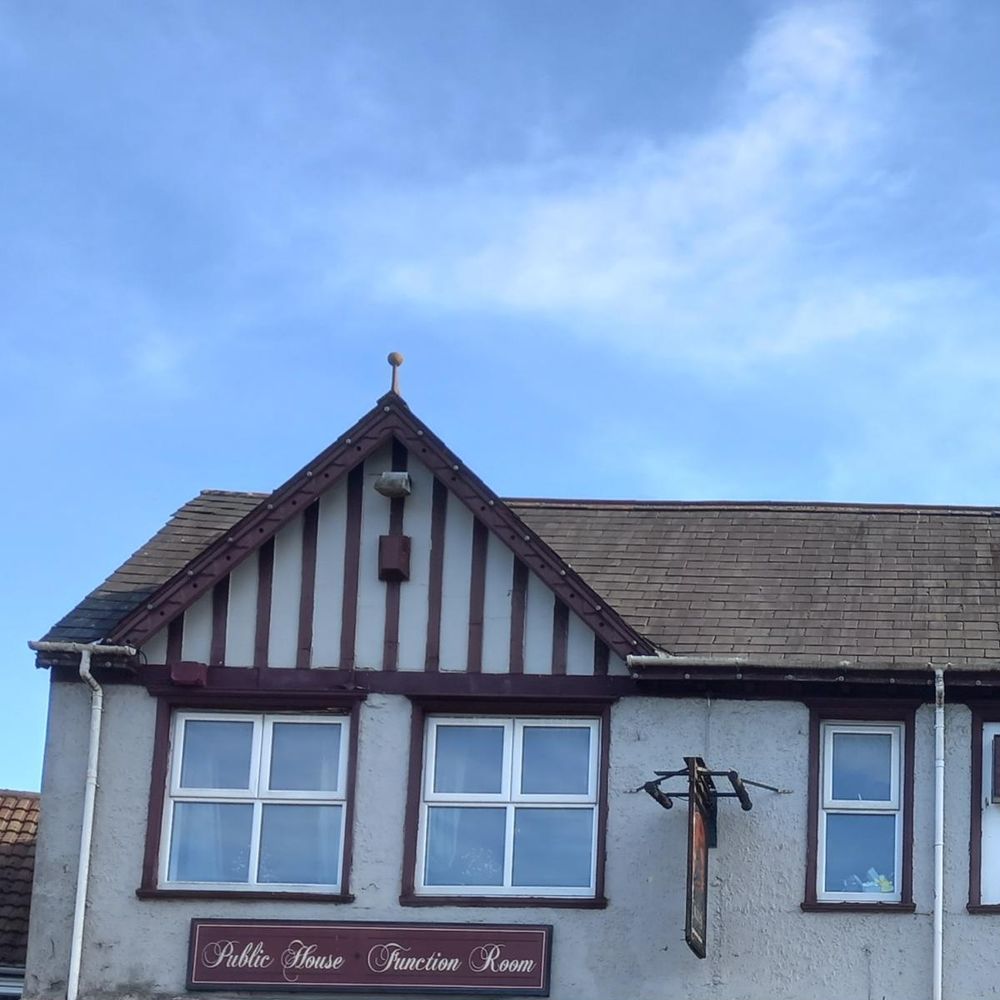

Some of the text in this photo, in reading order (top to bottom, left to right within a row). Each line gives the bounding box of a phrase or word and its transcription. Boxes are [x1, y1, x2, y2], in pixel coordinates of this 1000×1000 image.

[202, 939, 537, 982] Public House Function Room
